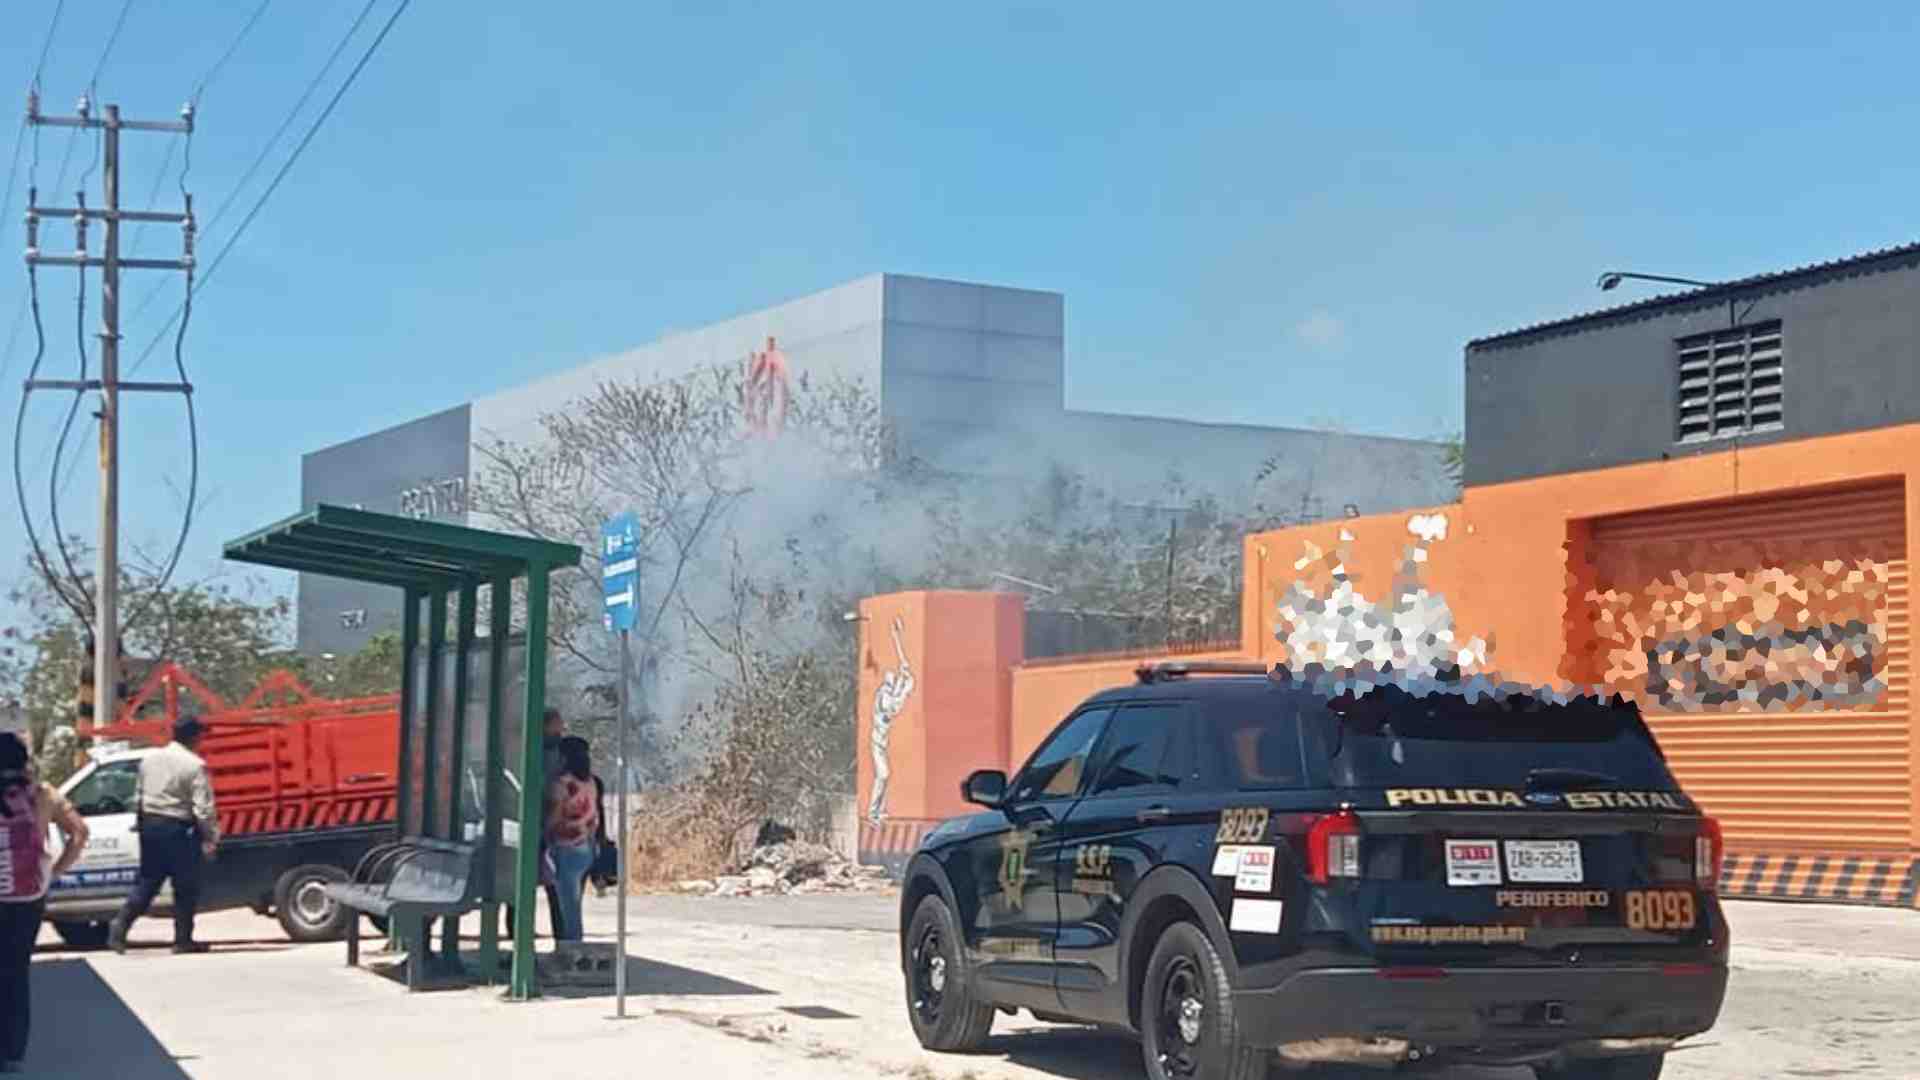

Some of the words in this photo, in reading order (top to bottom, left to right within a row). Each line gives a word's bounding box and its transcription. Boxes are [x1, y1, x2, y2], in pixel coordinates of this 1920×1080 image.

[1385, 788, 1526, 808] POLICIA
[1564, 791, 1682, 810] ESTATAL
[1215, 807, 1269, 843] 8093
[1496, 890, 1609, 907] PERIFERICO
[1626, 891, 1696, 930] 8093
